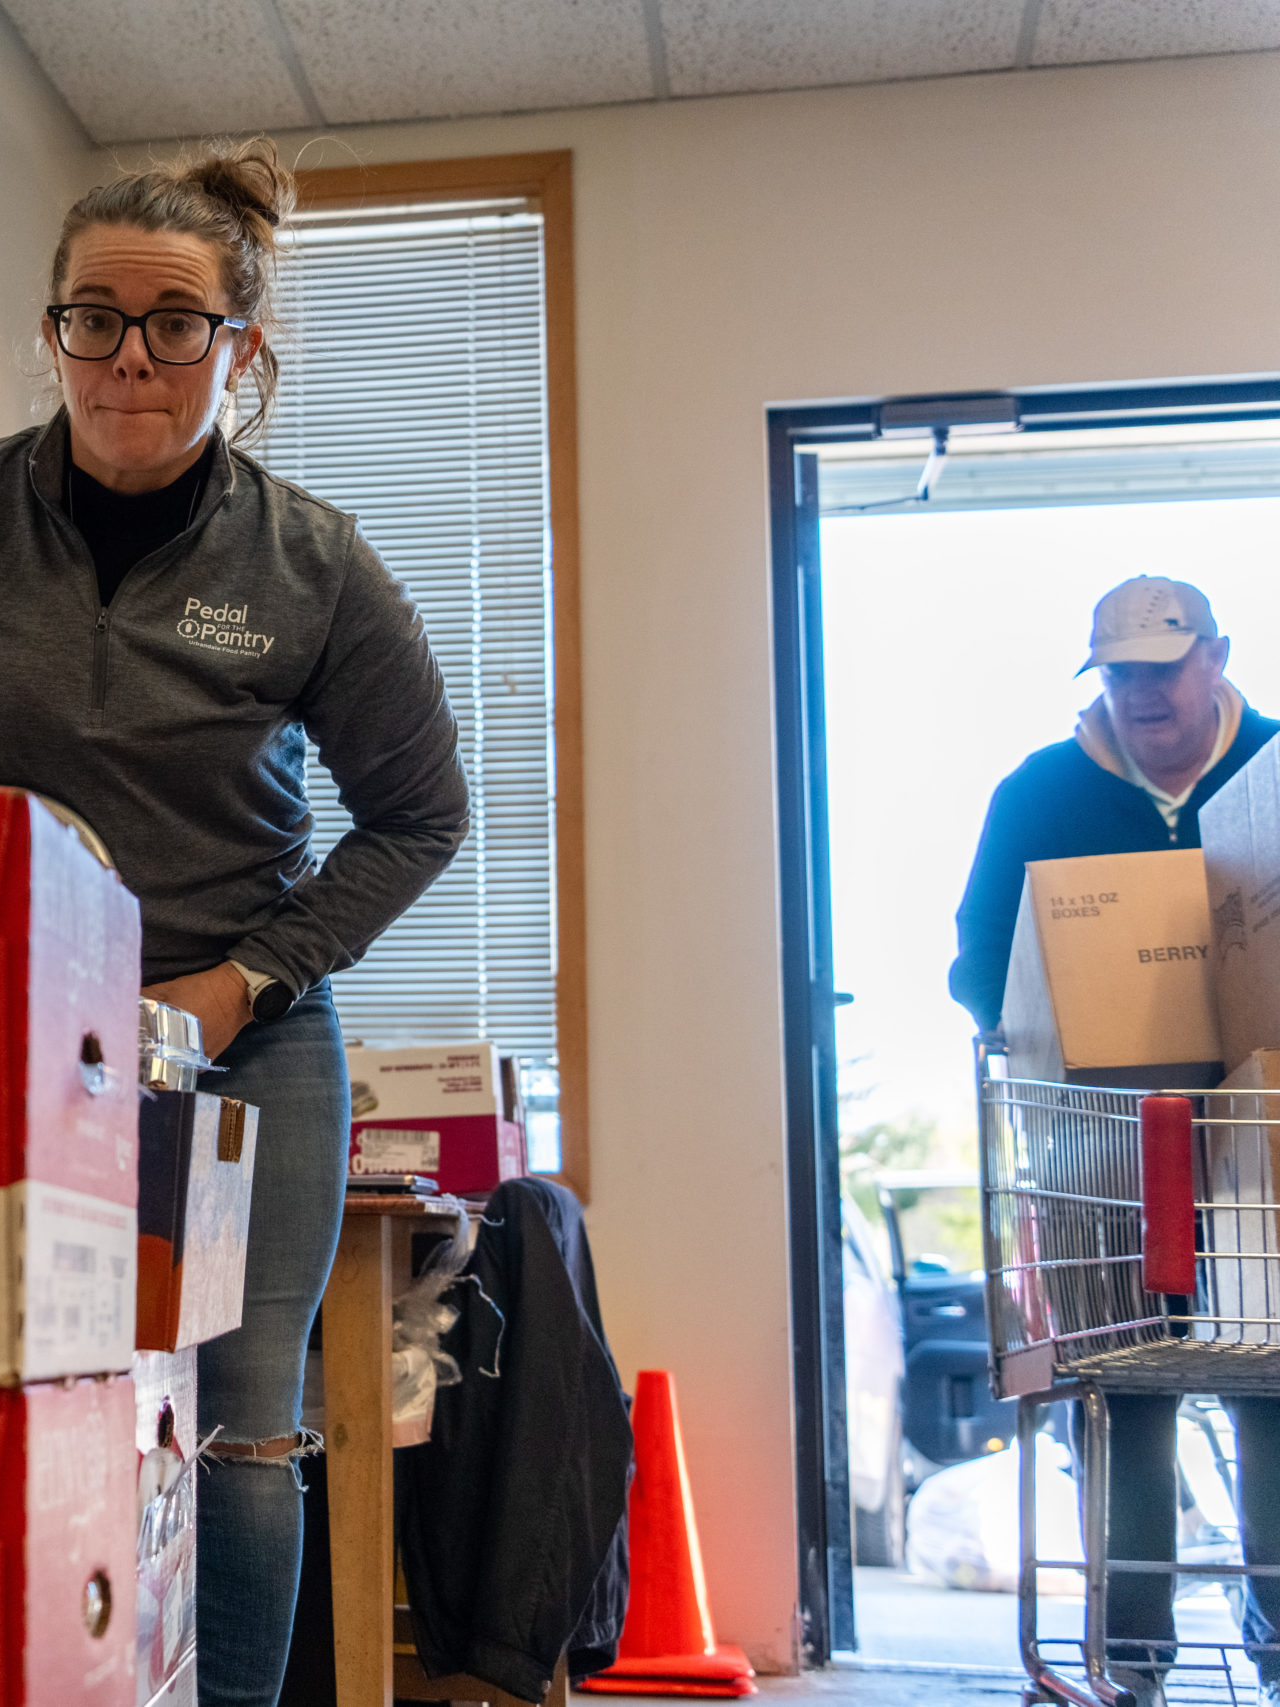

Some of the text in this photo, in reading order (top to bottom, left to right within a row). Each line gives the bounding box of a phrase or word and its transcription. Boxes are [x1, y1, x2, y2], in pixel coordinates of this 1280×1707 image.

[184, 597, 248, 624] Pedal
[216, 623, 246, 632] FOR THE
[200, 623, 275, 654] Pantry
[188, 640, 261, 659] Urbandale Food Pantry
[1051, 897, 1064, 907] 14
[1080, 894, 1095, 905] 13
[1098, 892, 1119, 904] OZ
[1051, 906, 1101, 920] BOXES
[1138, 945, 1208, 963] BERRY
